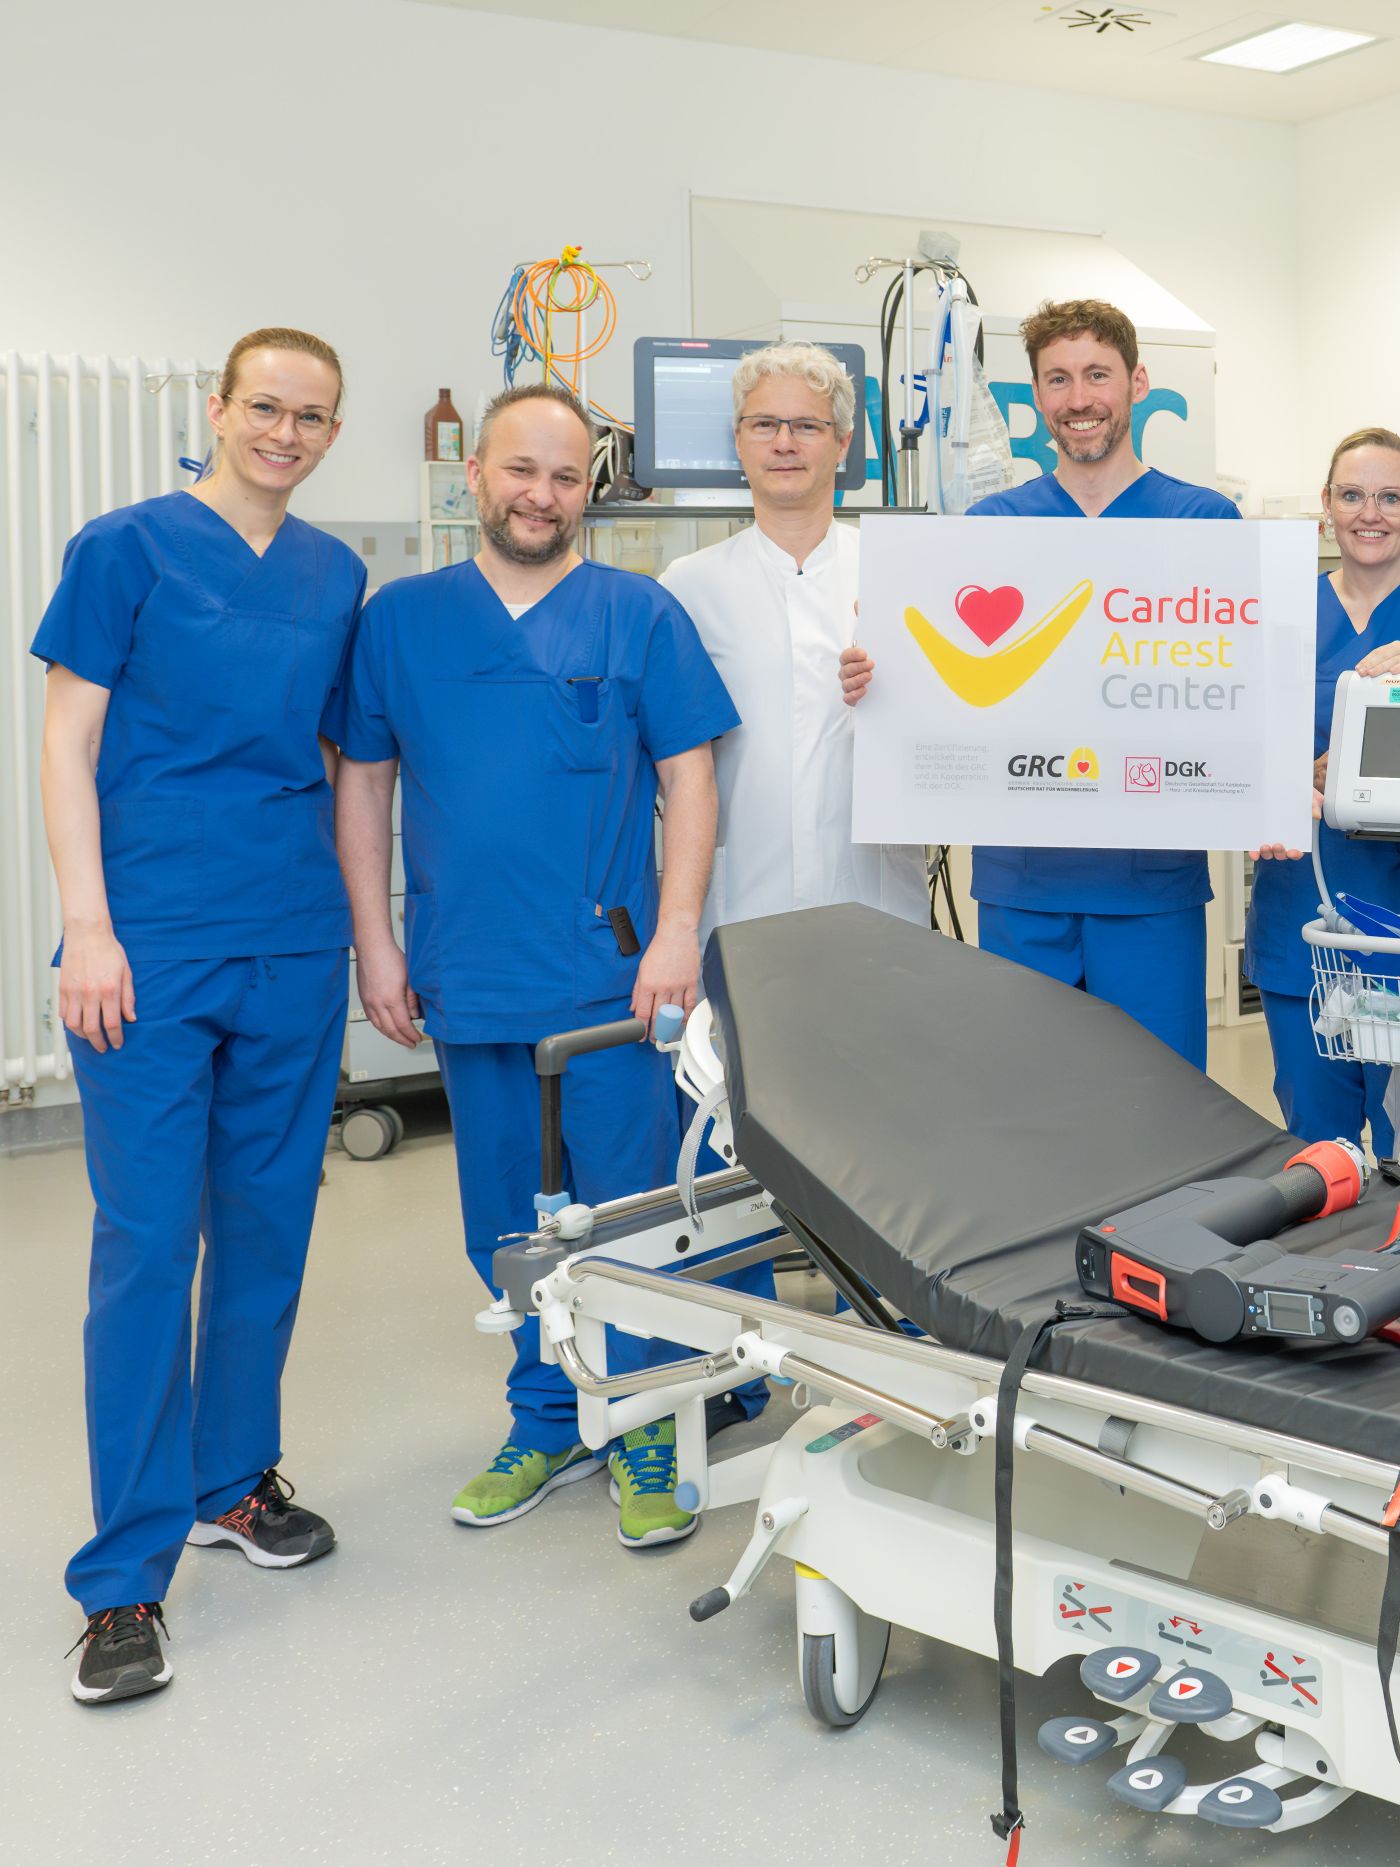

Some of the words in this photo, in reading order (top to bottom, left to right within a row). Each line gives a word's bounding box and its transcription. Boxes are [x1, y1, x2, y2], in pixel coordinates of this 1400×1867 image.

[1103, 586, 1259, 625] Cardiac
[1100, 631, 1233, 668] Arrest
[1101, 673, 1246, 711] Center
[1007, 754, 1065, 778] GRC
